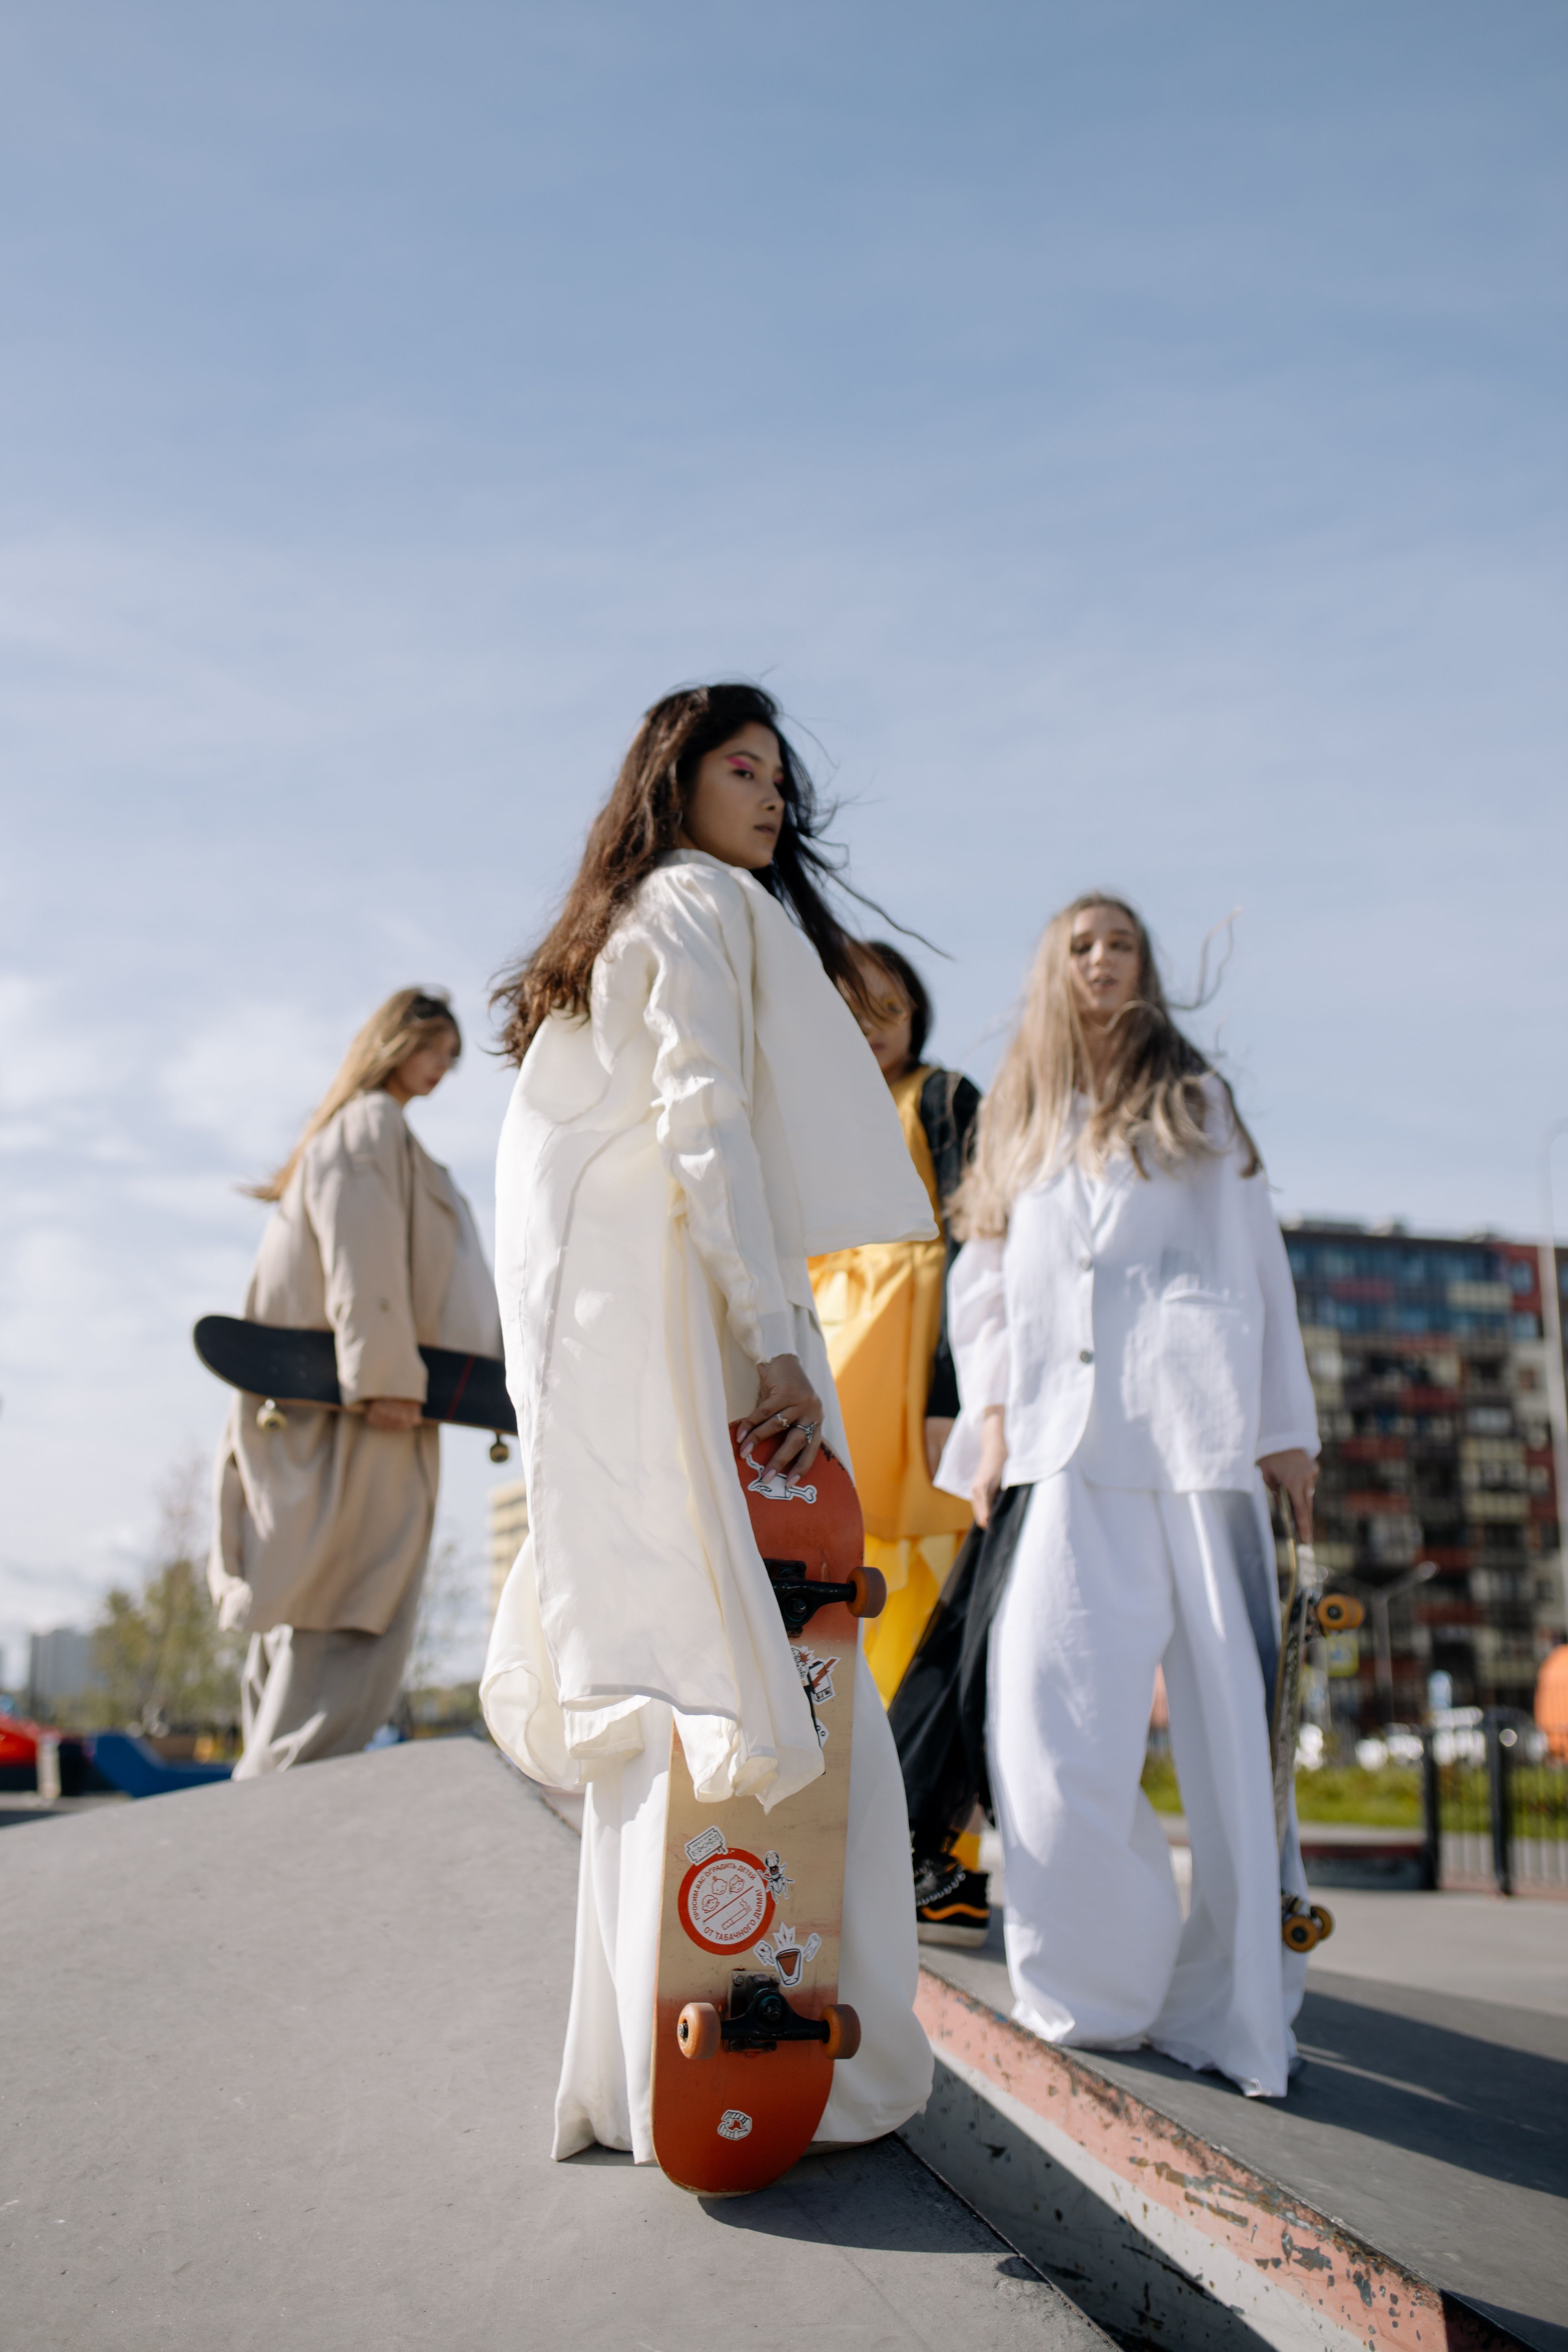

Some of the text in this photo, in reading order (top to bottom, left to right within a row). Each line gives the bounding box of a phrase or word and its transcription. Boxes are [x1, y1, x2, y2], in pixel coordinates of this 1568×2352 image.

[692, 1863, 757, 1920] ПРОСИМ ВАС ОГРАДИТЬ ДЕТЕЙ
[704, 1889, 763, 1941] ОТ ТАБАЧНОГО ДЫМА!
